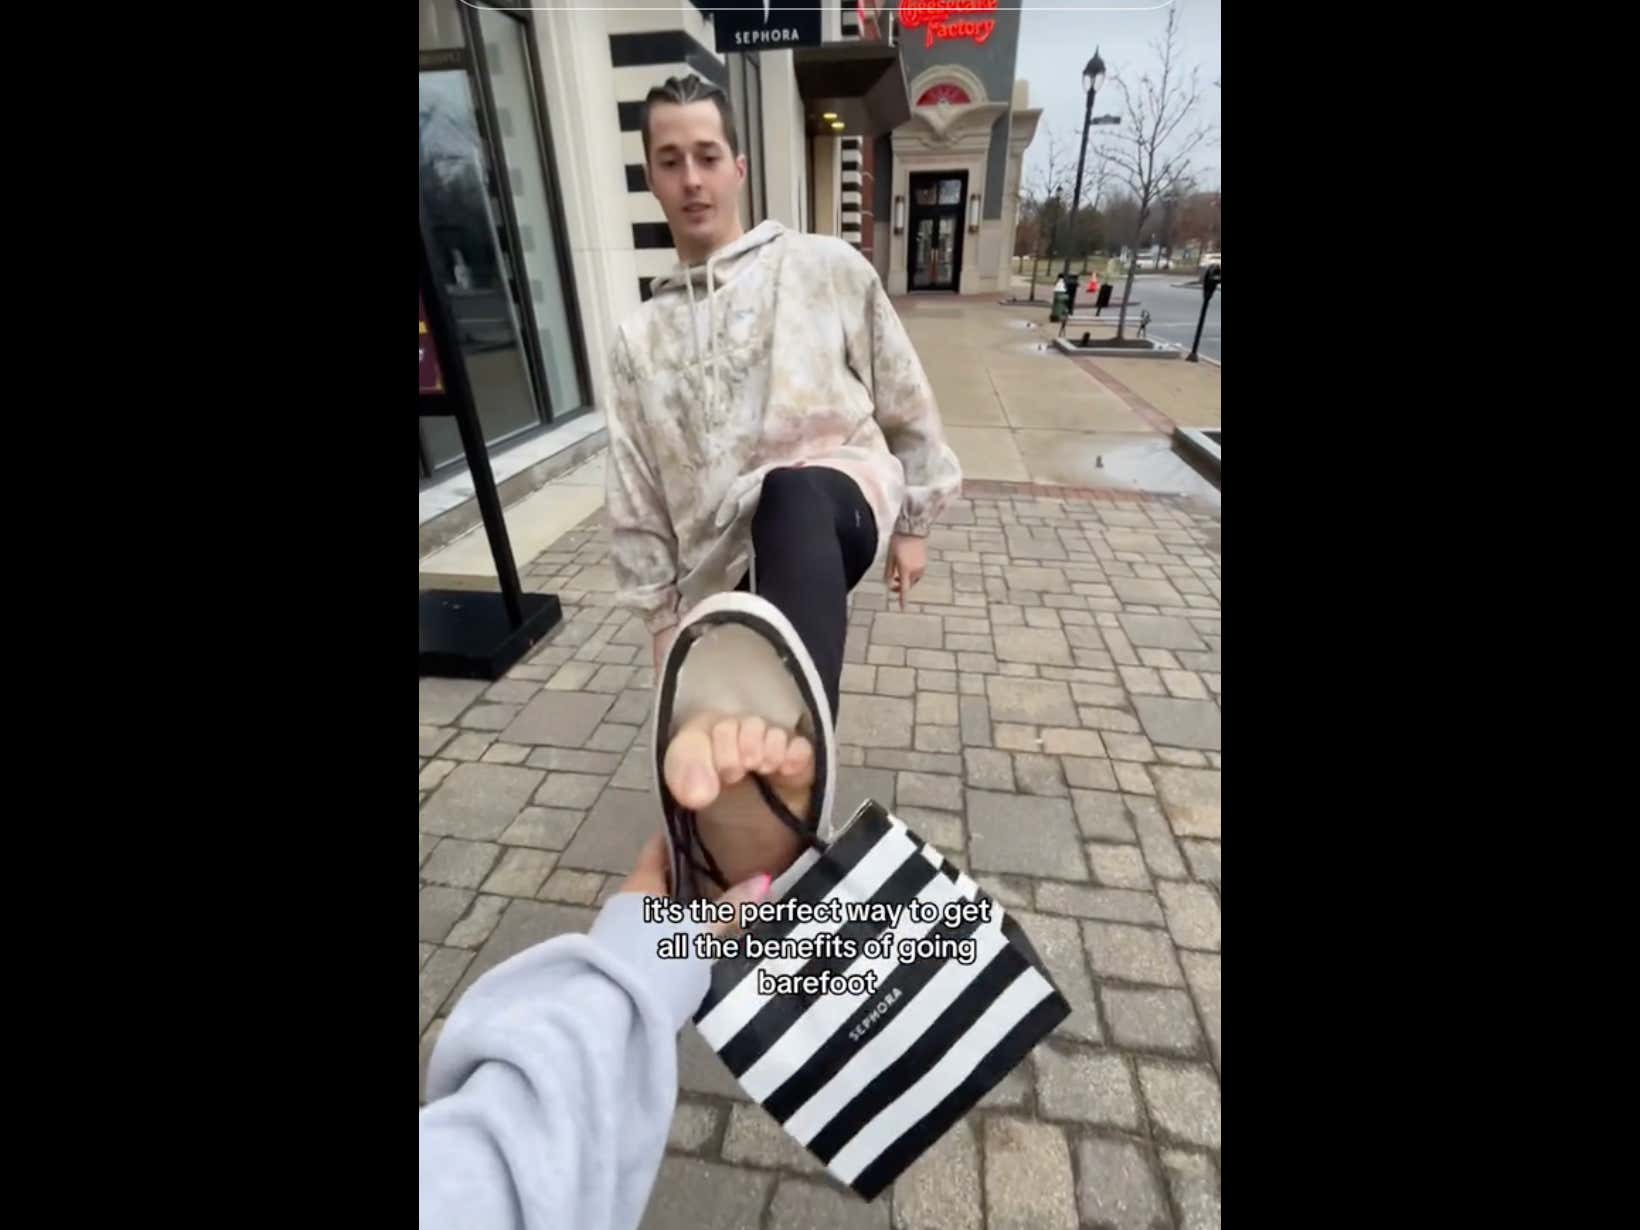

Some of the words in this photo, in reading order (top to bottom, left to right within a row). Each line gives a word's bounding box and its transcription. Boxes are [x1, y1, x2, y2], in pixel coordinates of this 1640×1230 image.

[734, 28, 800, 45] SEPHORA
[923, 17, 996, 49] Factory
[848, 987, 903, 1042] SEPHORA
